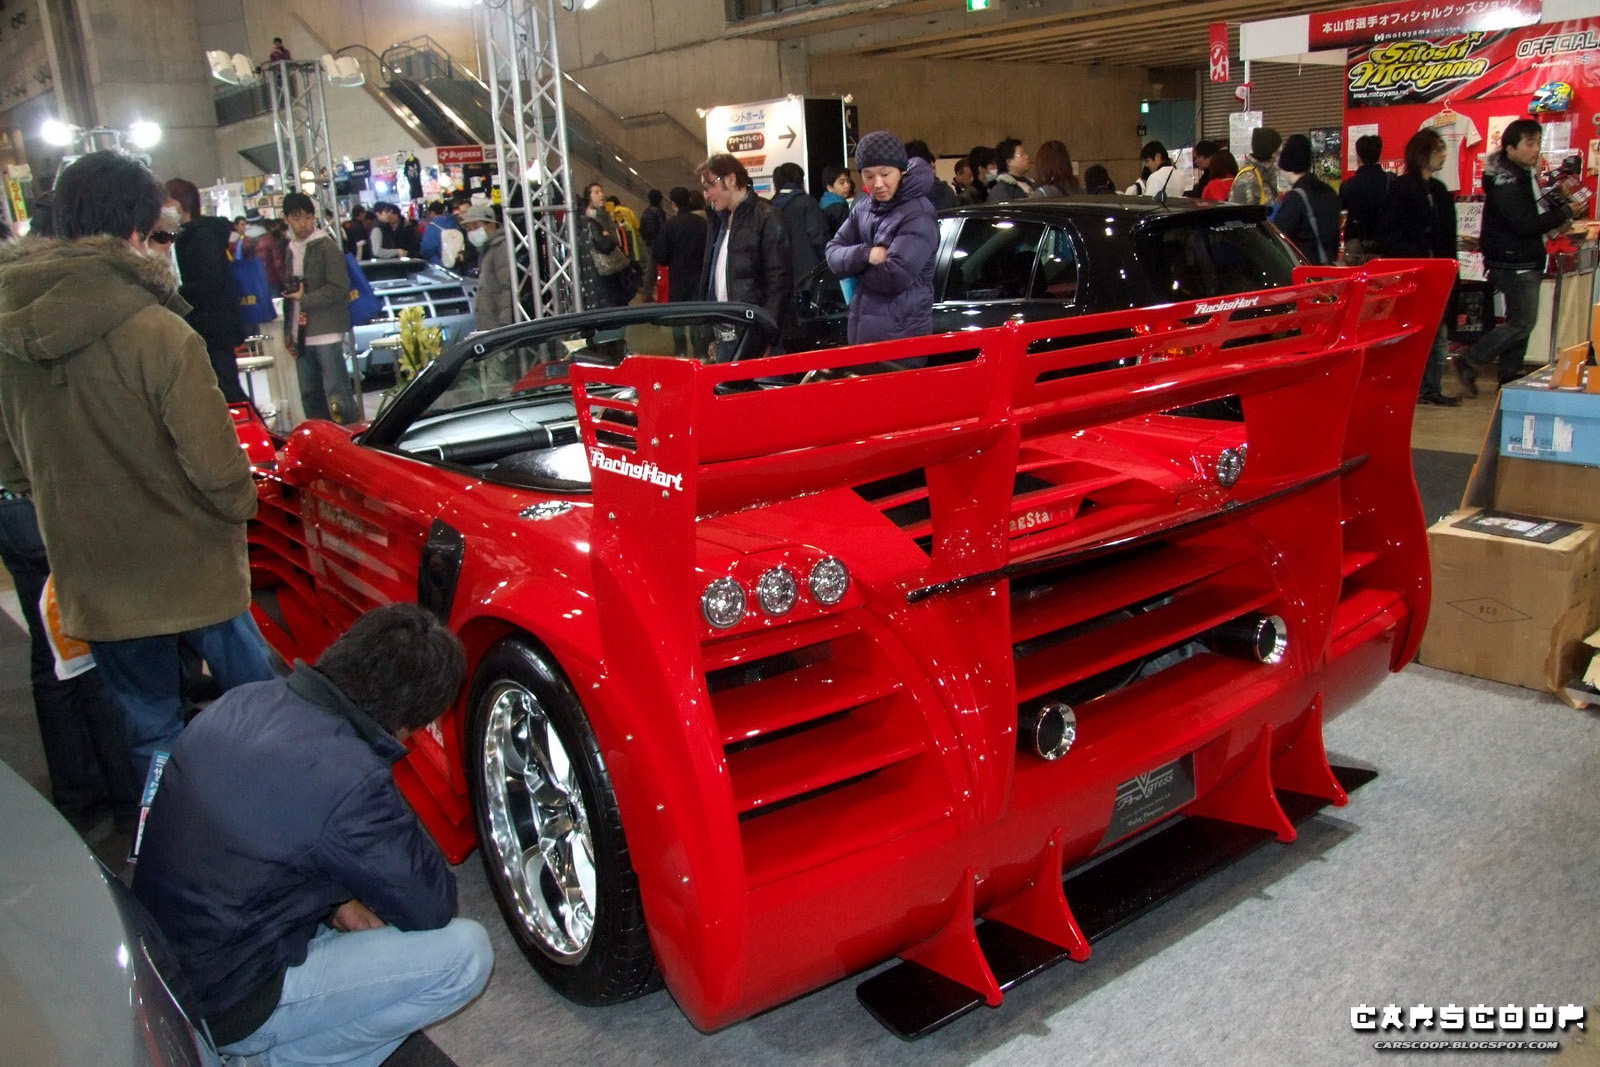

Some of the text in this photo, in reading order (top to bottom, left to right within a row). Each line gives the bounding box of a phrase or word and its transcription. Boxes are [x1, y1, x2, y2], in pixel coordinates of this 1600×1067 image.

[1517, 31, 1597, 59] OFFICIAL
[1194, 296, 1259, 315] RacingHart
[589, 446, 683, 491] RacingHart
